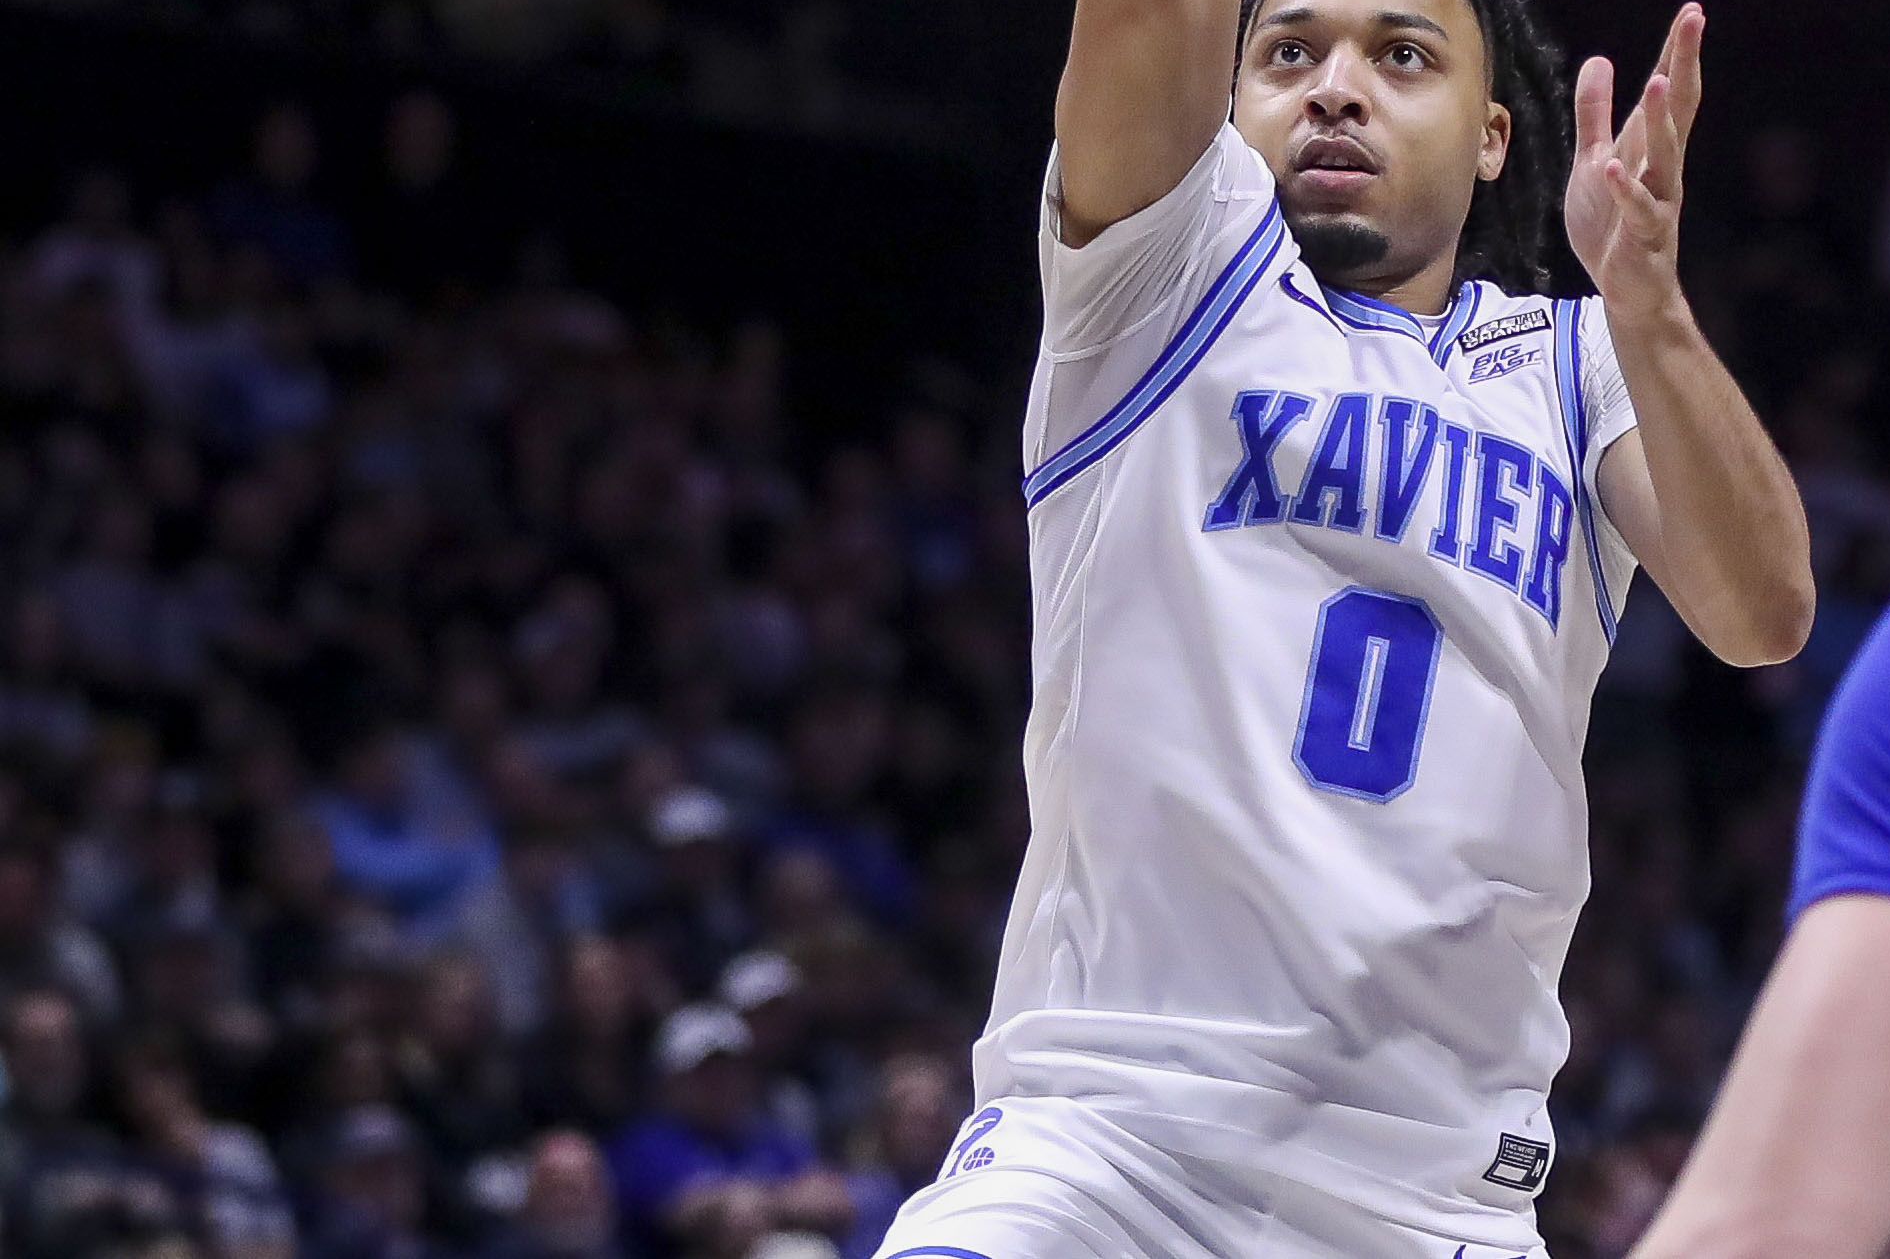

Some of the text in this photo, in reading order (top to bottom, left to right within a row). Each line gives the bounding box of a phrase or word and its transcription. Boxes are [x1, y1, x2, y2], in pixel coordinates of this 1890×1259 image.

[1470, 348, 1542, 379] EAST
[1473, 343, 1522, 370] BIG
[1201, 390, 1576, 637] XAVIER
[1292, 584, 1444, 803] 0
